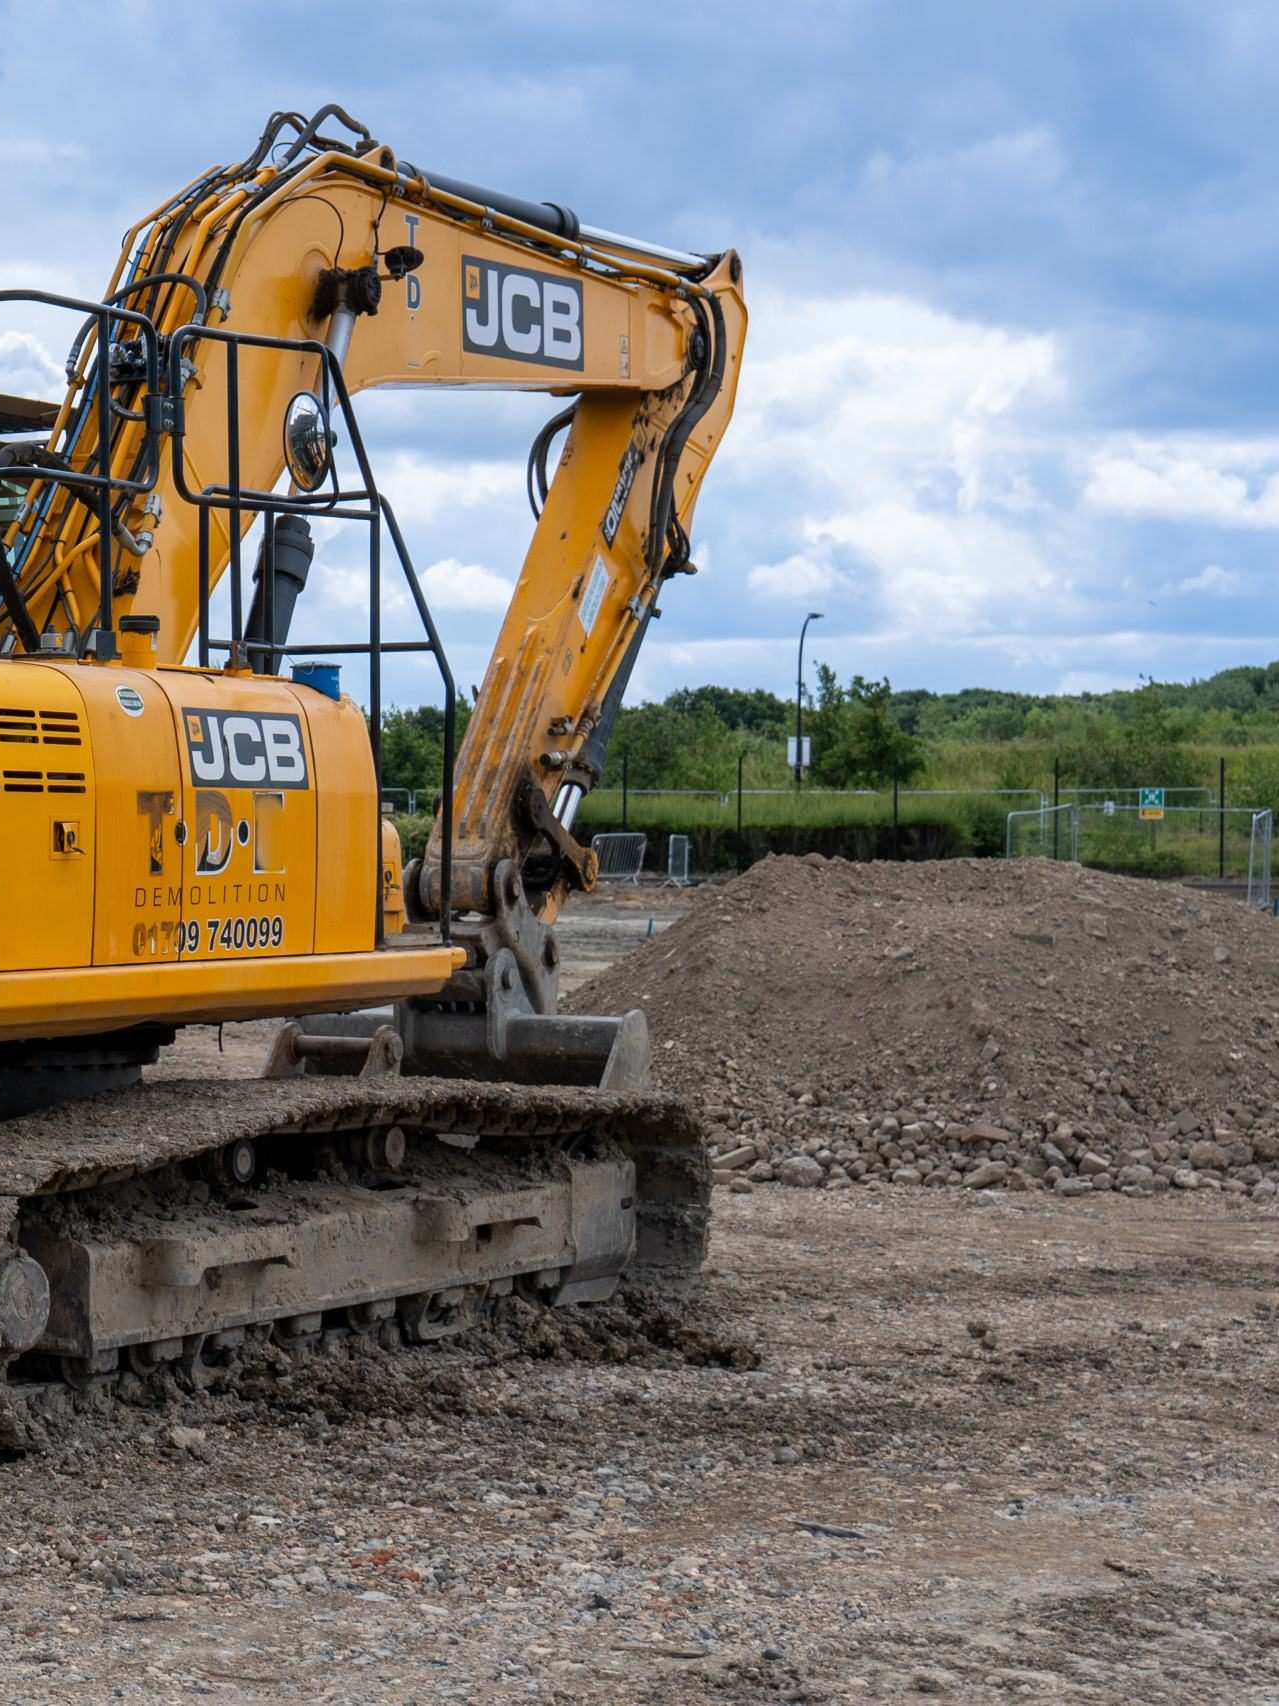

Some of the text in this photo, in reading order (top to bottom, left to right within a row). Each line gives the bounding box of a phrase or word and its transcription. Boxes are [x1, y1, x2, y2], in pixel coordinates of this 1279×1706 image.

[465, 269, 582, 361] JCB
[191, 716, 305, 782] JCB
[134, 883, 286, 908] DEMOLITION
[132, 914, 284, 957] 01709 740099
